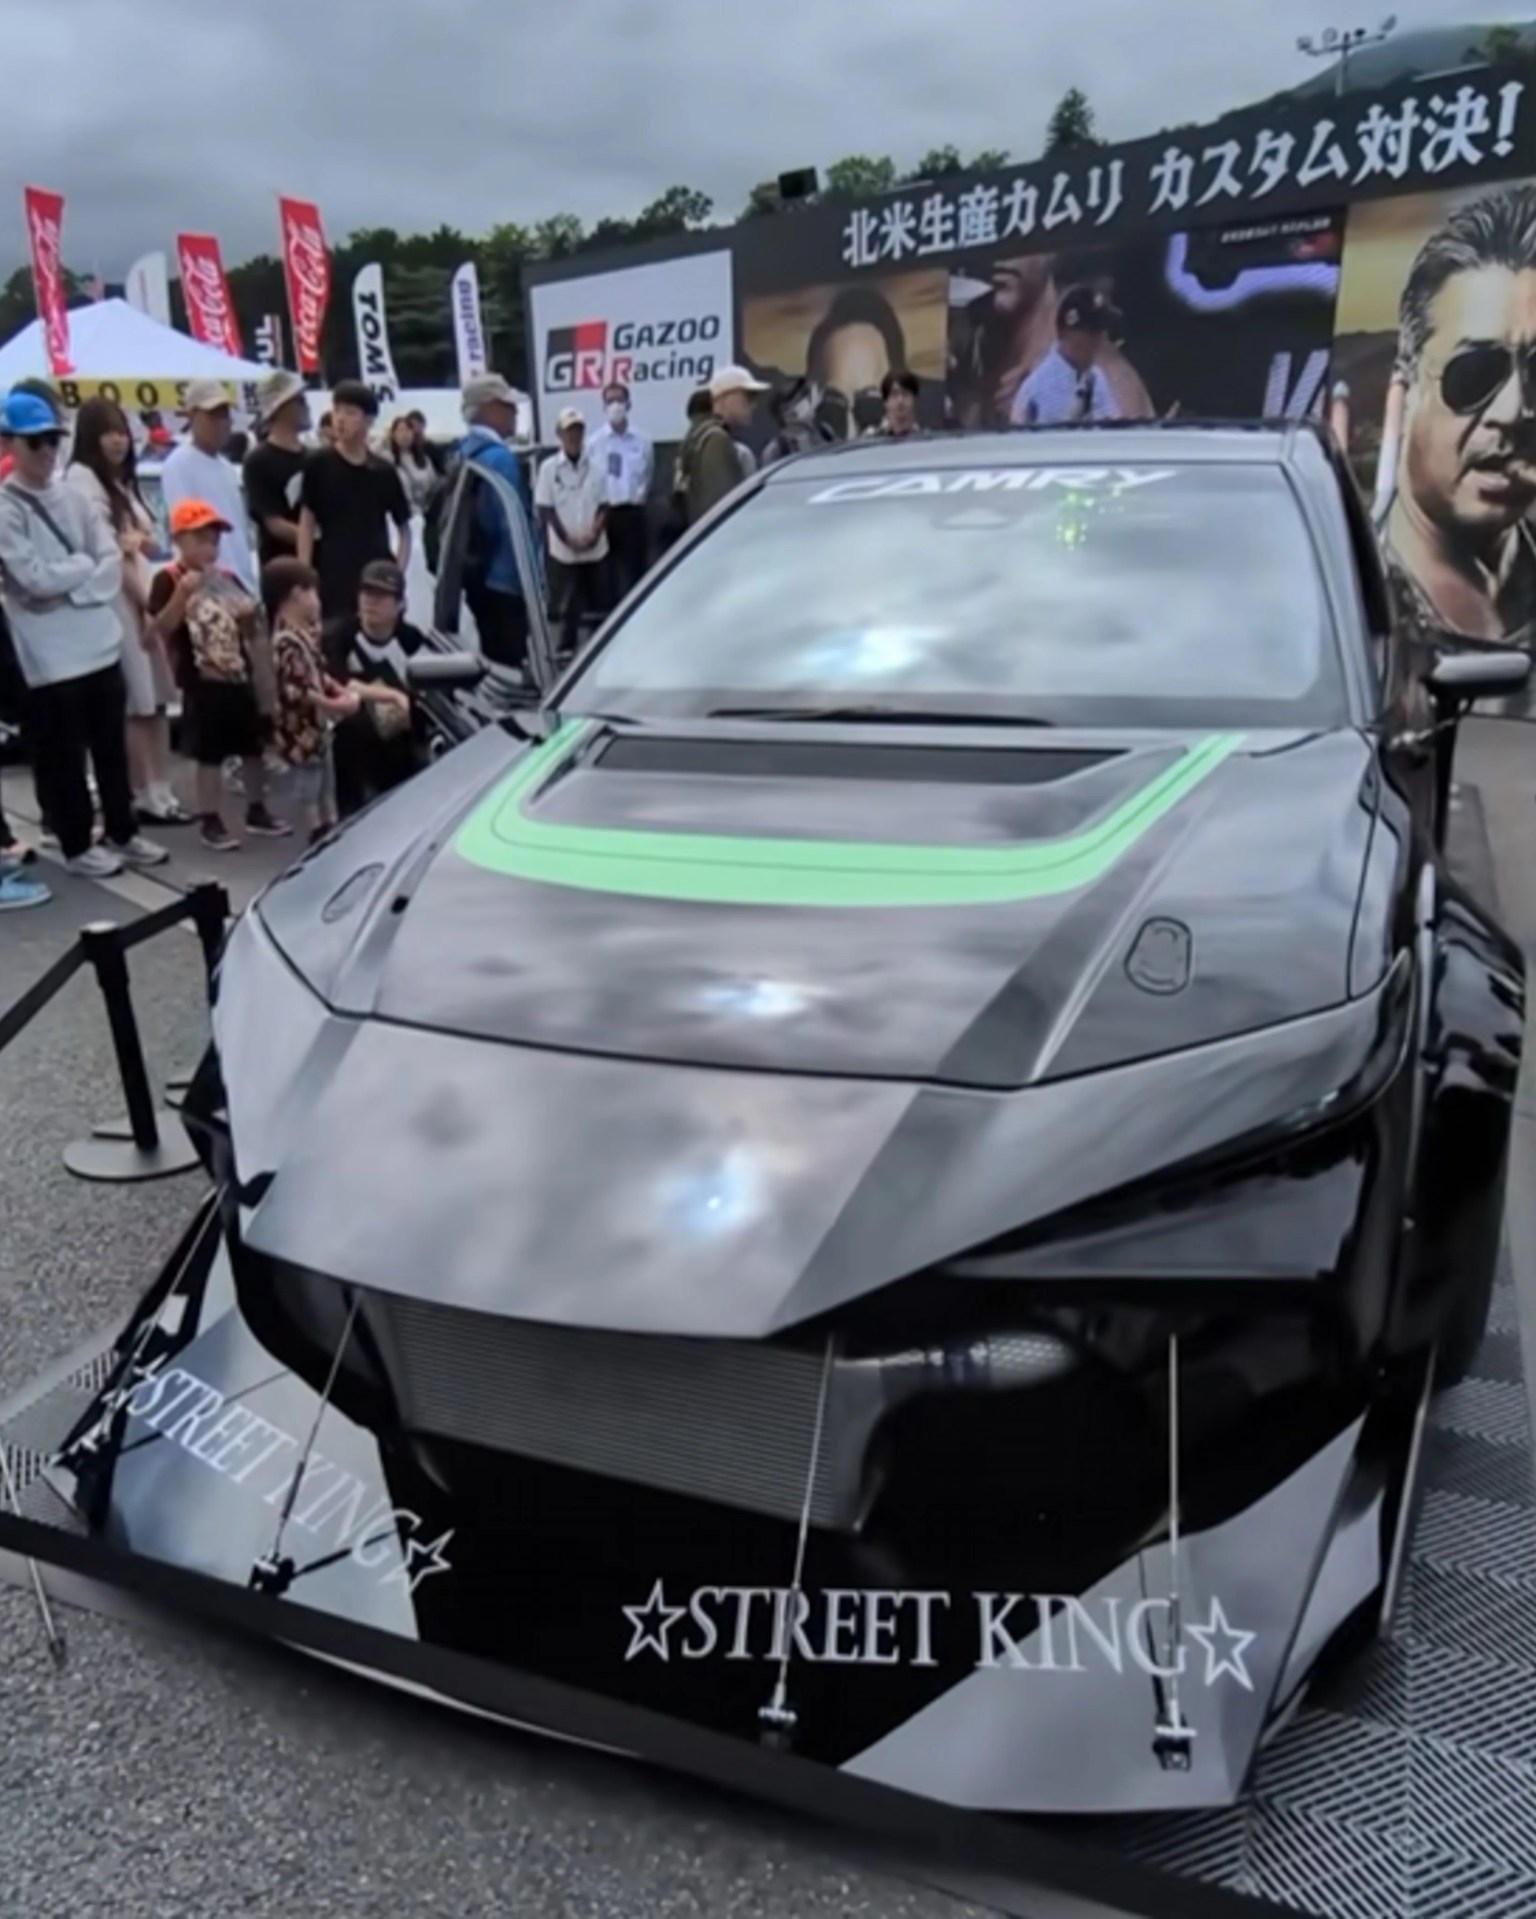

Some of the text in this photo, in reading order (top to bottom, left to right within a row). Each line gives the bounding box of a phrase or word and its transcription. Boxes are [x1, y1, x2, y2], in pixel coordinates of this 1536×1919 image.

[842, 80, 1525, 267] 北米生産カムリ カスタム対決!
[613, 314, 720, 351] GAZOO
[546, 351, 604, 392] GR
[611, 352, 715, 387] Racing
[808, 468, 1180, 504] CAMRY
[127, 1367, 421, 1568] STREET KING
[681, 1585, 1188, 1677] STREET KING
